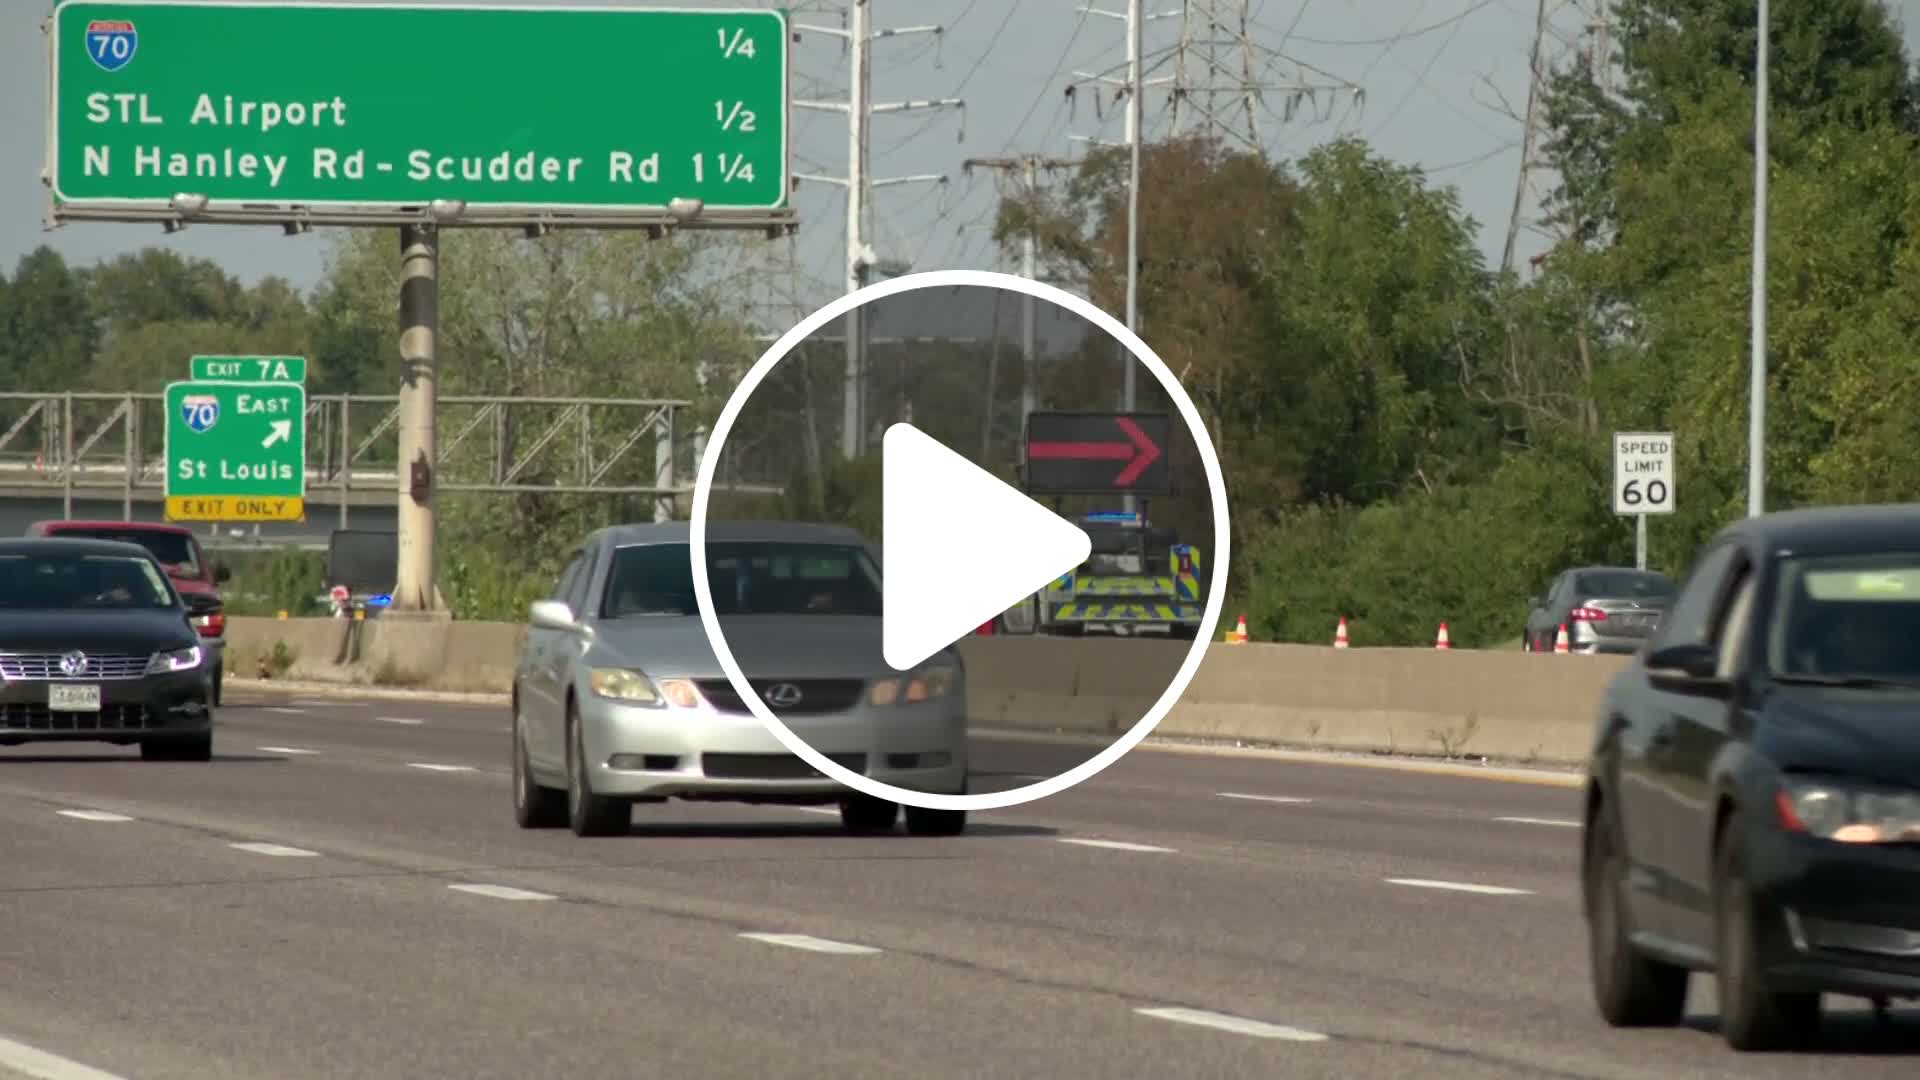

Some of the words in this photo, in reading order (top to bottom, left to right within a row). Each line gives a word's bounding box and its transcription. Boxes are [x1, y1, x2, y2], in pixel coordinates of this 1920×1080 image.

[93, 35, 129, 60] 70
[86, 93, 162, 123] STL
[190, 94, 346, 131] Airport
[84, 146, 109, 176] N
[135, 146, 287, 187] Hanley
[609, 151, 659, 182] Rd
[206, 362, 242, 377] EXIT
[257, 360, 290, 380] 7A
[184, 404, 214, 426] 70
[236, 394, 291, 414] EAST
[1620, 441, 1669, 454] SPEED
[178, 458, 207, 480] St
[220, 459, 293, 480] Louis
[1624, 461, 1664, 472] LIMIT
[1622, 479, 1667, 505] 60
[182, 500, 225, 514] EXIT
[236, 501, 286, 515] ONLY
